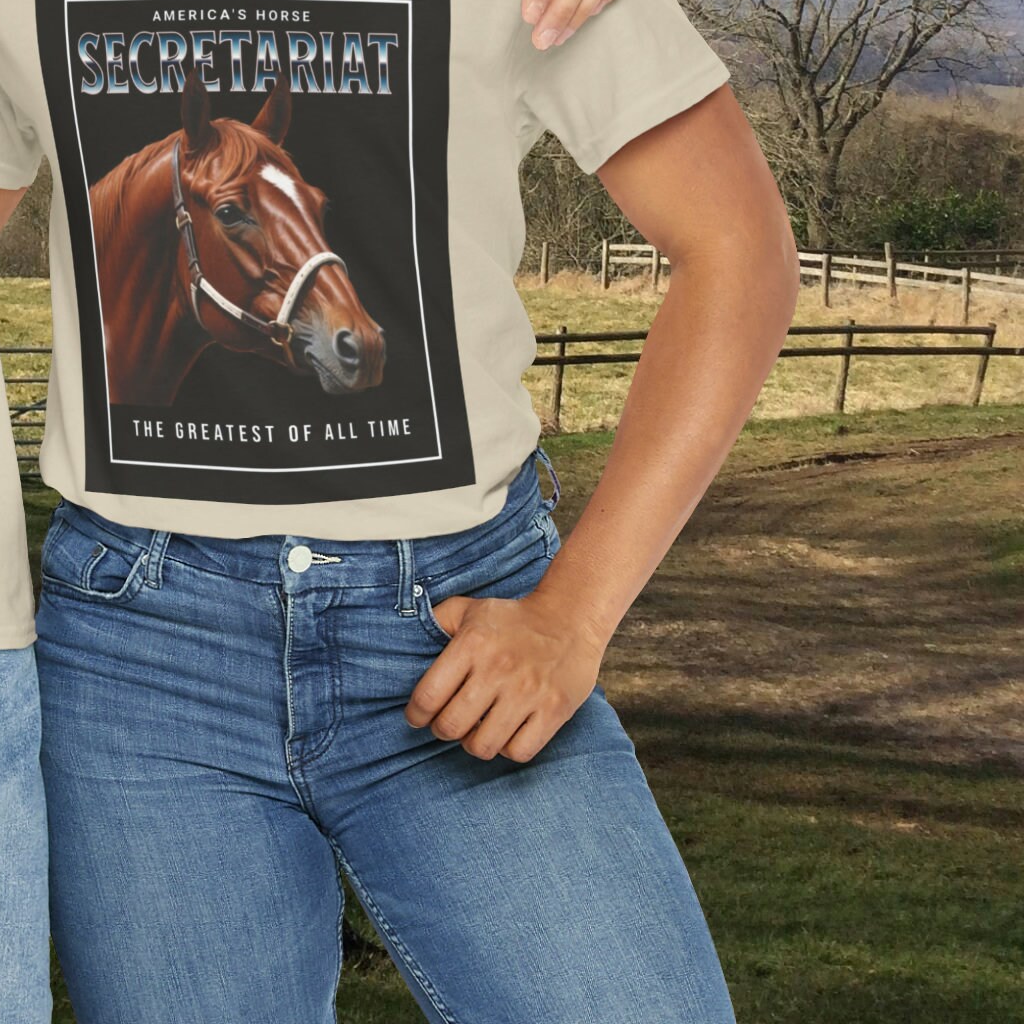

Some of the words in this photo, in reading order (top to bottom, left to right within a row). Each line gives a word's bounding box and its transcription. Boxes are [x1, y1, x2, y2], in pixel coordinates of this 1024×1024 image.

[153, 9, 246, 21] AMERICA'S
[256, 10, 310, 22] HORSE
[77, 30, 399, 95] SECRETARIAT
[133, 420, 164, 437] THE
[175, 422, 274, 442] GREATEST
[289, 425, 311, 442] OF
[325, 422, 357, 440] ALL
[368, 419, 411, 437] TIME
